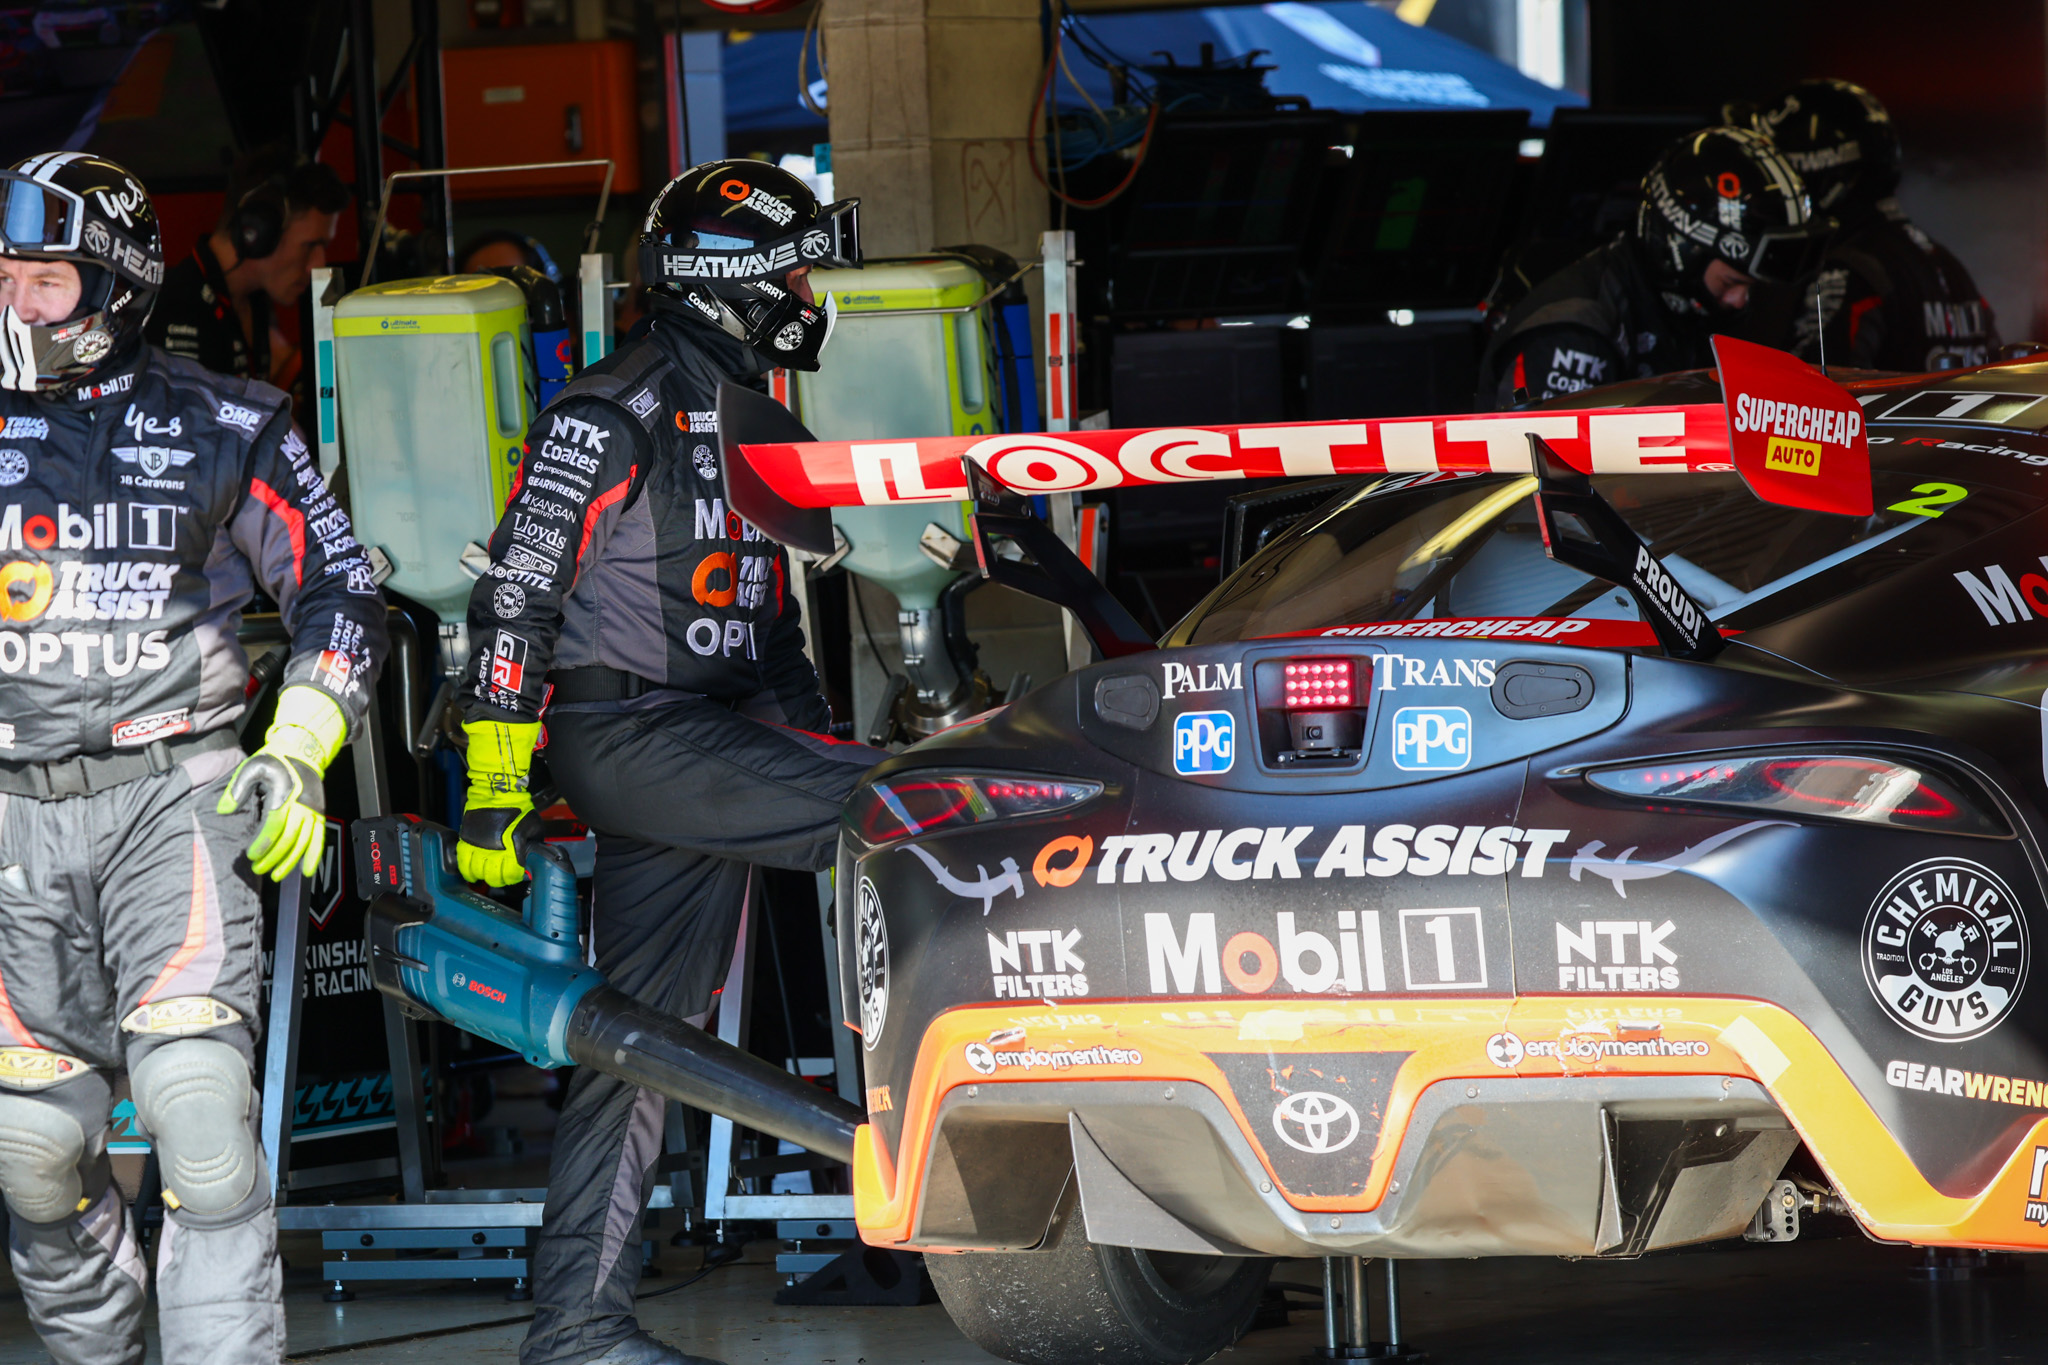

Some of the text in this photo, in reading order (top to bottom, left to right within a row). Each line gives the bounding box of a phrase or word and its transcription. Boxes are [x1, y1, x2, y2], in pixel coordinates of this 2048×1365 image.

[742, 197, 791, 227] ASSIST
[751, 188, 797, 220] TRUCK
[663, 241, 798, 279] HEATWAVE
[111, 290, 133, 313] KYLE
[752, 280, 787, 300] ARRY
[688, 292, 720, 321] Coates
[1552, 347, 1607, 381] NTK
[78, 378, 119, 401] Mobil
[632, 391, 655, 415] OMP
[219, 405, 261, 427] OMP
[1735, 393, 1861, 449] SUPERCHEAP
[549, 414, 610, 454] NTK
[541, 439, 600, 475] Coates
[850, 412, 1686, 505] LOCTITE
[1772, 446, 1815, 468] AUTO
[1901, 437, 2048, 466] Racing
[135, 475, 185, 490] Caravans
[527, 476, 587, 505] GEARWRENCH
[527, 506, 554, 520] INSTITUTE
[529, 496, 577, 524] KANGAN
[1886, 482, 1968, 518] 2
[0, 503, 117, 550] Mobil
[513, 512, 567, 550] Lloyds
[60, 561, 181, 592] TRUCK
[486, 561, 553, 590] LOCTITE
[45, 590, 170, 621] ASSIST
[1636, 545, 1702, 640] PROUDI
[1632, 572, 1648, 593] SUPER
[1646, 588, 1668, 617] PREMIUM
[1684, 632, 1697, 650] FOOD
[0, 630, 171, 678] OPTUS
[494, 633, 515, 686] GR
[1177, 712, 1231, 768] PPG
[1397, 712, 1467, 764] PPG
[1097, 825, 1570, 884] TRUCK ASSIST
[1876, 873, 2018, 958] CHEMICAL
[987, 927, 1085, 974] NTK
[1144, 909, 1387, 994] Mobil
[1556, 919, 1678, 964] NTK
[1876, 952, 1905, 963] TRADITION
[1991, 965, 2016, 975] LIFESTYLE
[314, 966, 372, 998] RACIN
[468, 980, 507, 1004] BOSCH
[993, 974, 1089, 998] FILTERS
[1559, 966, 1680, 990] FILTERS
[1930, 973, 1964, 984] ANGELES
[1897, 983, 1989, 1027] GUYS
[995, 1045, 1142, 1071] employmenthero
